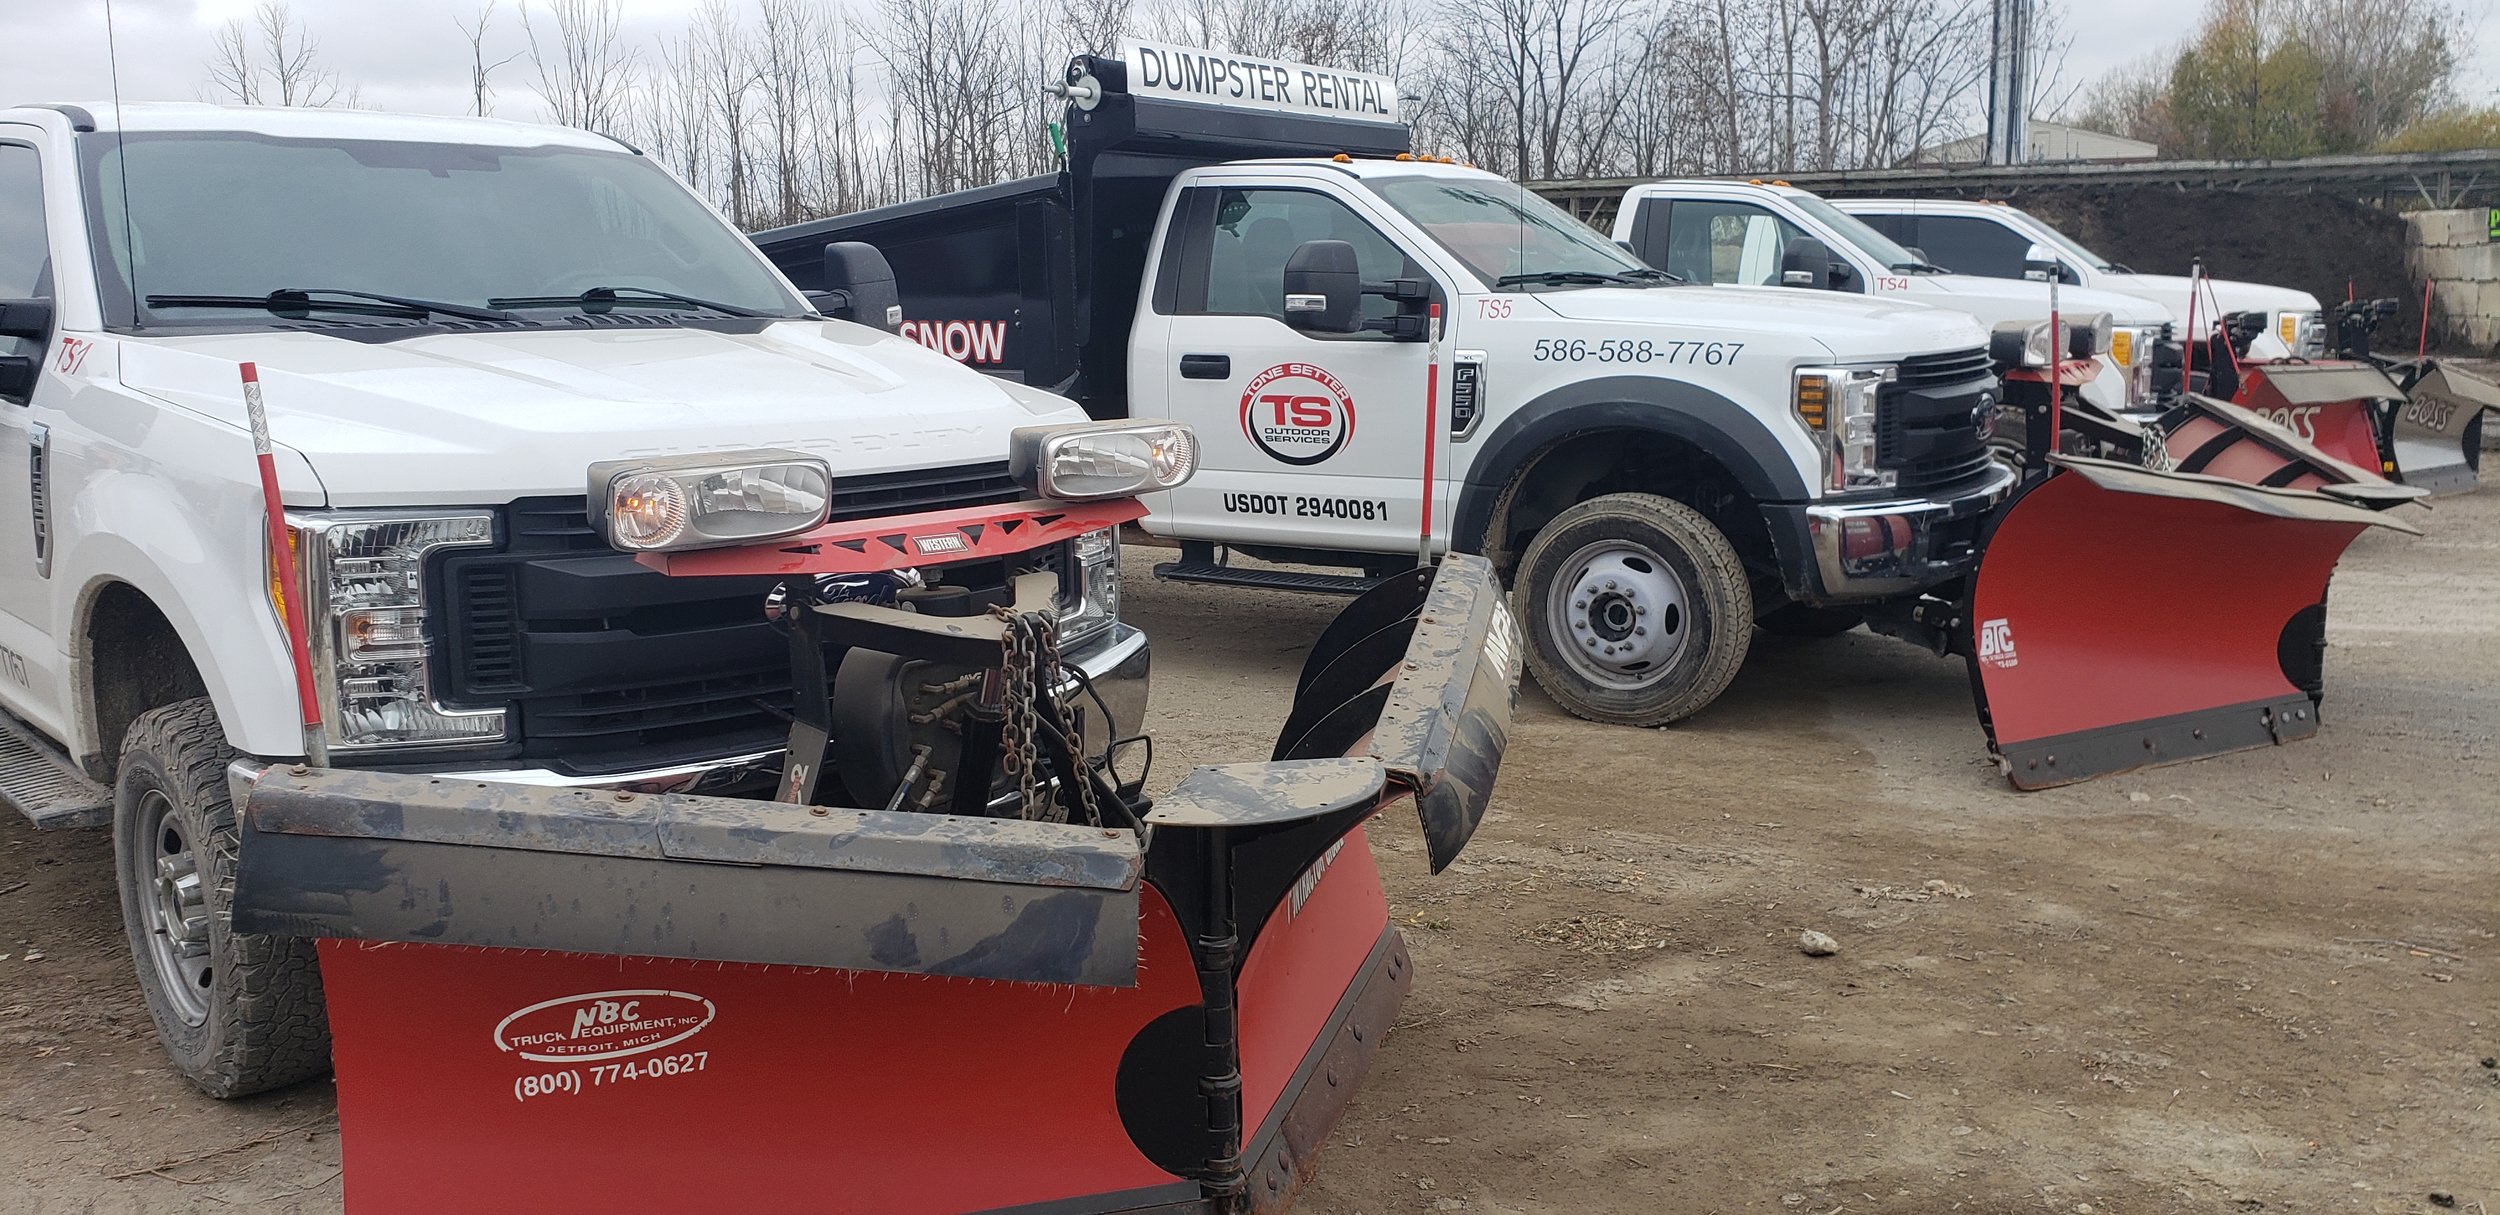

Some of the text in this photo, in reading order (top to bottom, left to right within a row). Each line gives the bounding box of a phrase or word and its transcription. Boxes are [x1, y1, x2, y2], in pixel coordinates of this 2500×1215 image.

[1139, 47, 1389, 115] DUMPSTER RENTAL
[1877, 277, 1908, 291] TS4
[1478, 299, 1513, 320] TS5
[54, 338, 93, 375] TS1
[900, 320, 1006, 363] SNOW
[1533, 339, 1745, 365] 586-588-7767
[1244, 364, 1349, 401] TONE SETTER
[1260, 395, 1332, 427] TS
[2406, 393, 2454, 431] BOSS
[1264, 428, 1331, 437] OUTDOOR
[1265, 435, 1331, 444] SERVICES
[1223, 493, 1388, 521] USDOT 2940081
[919, 537, 961, 552] WESTERN
[1980, 618, 2015, 656] BTC
[511, 1016, 698, 1047] TRUCK EQUIPMENT, INC
[571, 1000, 640, 1039] NBC
[546, 1032, 661, 1053] DETROIT, MICH
[514, 1051, 709, 1102] (800) 774-0627
